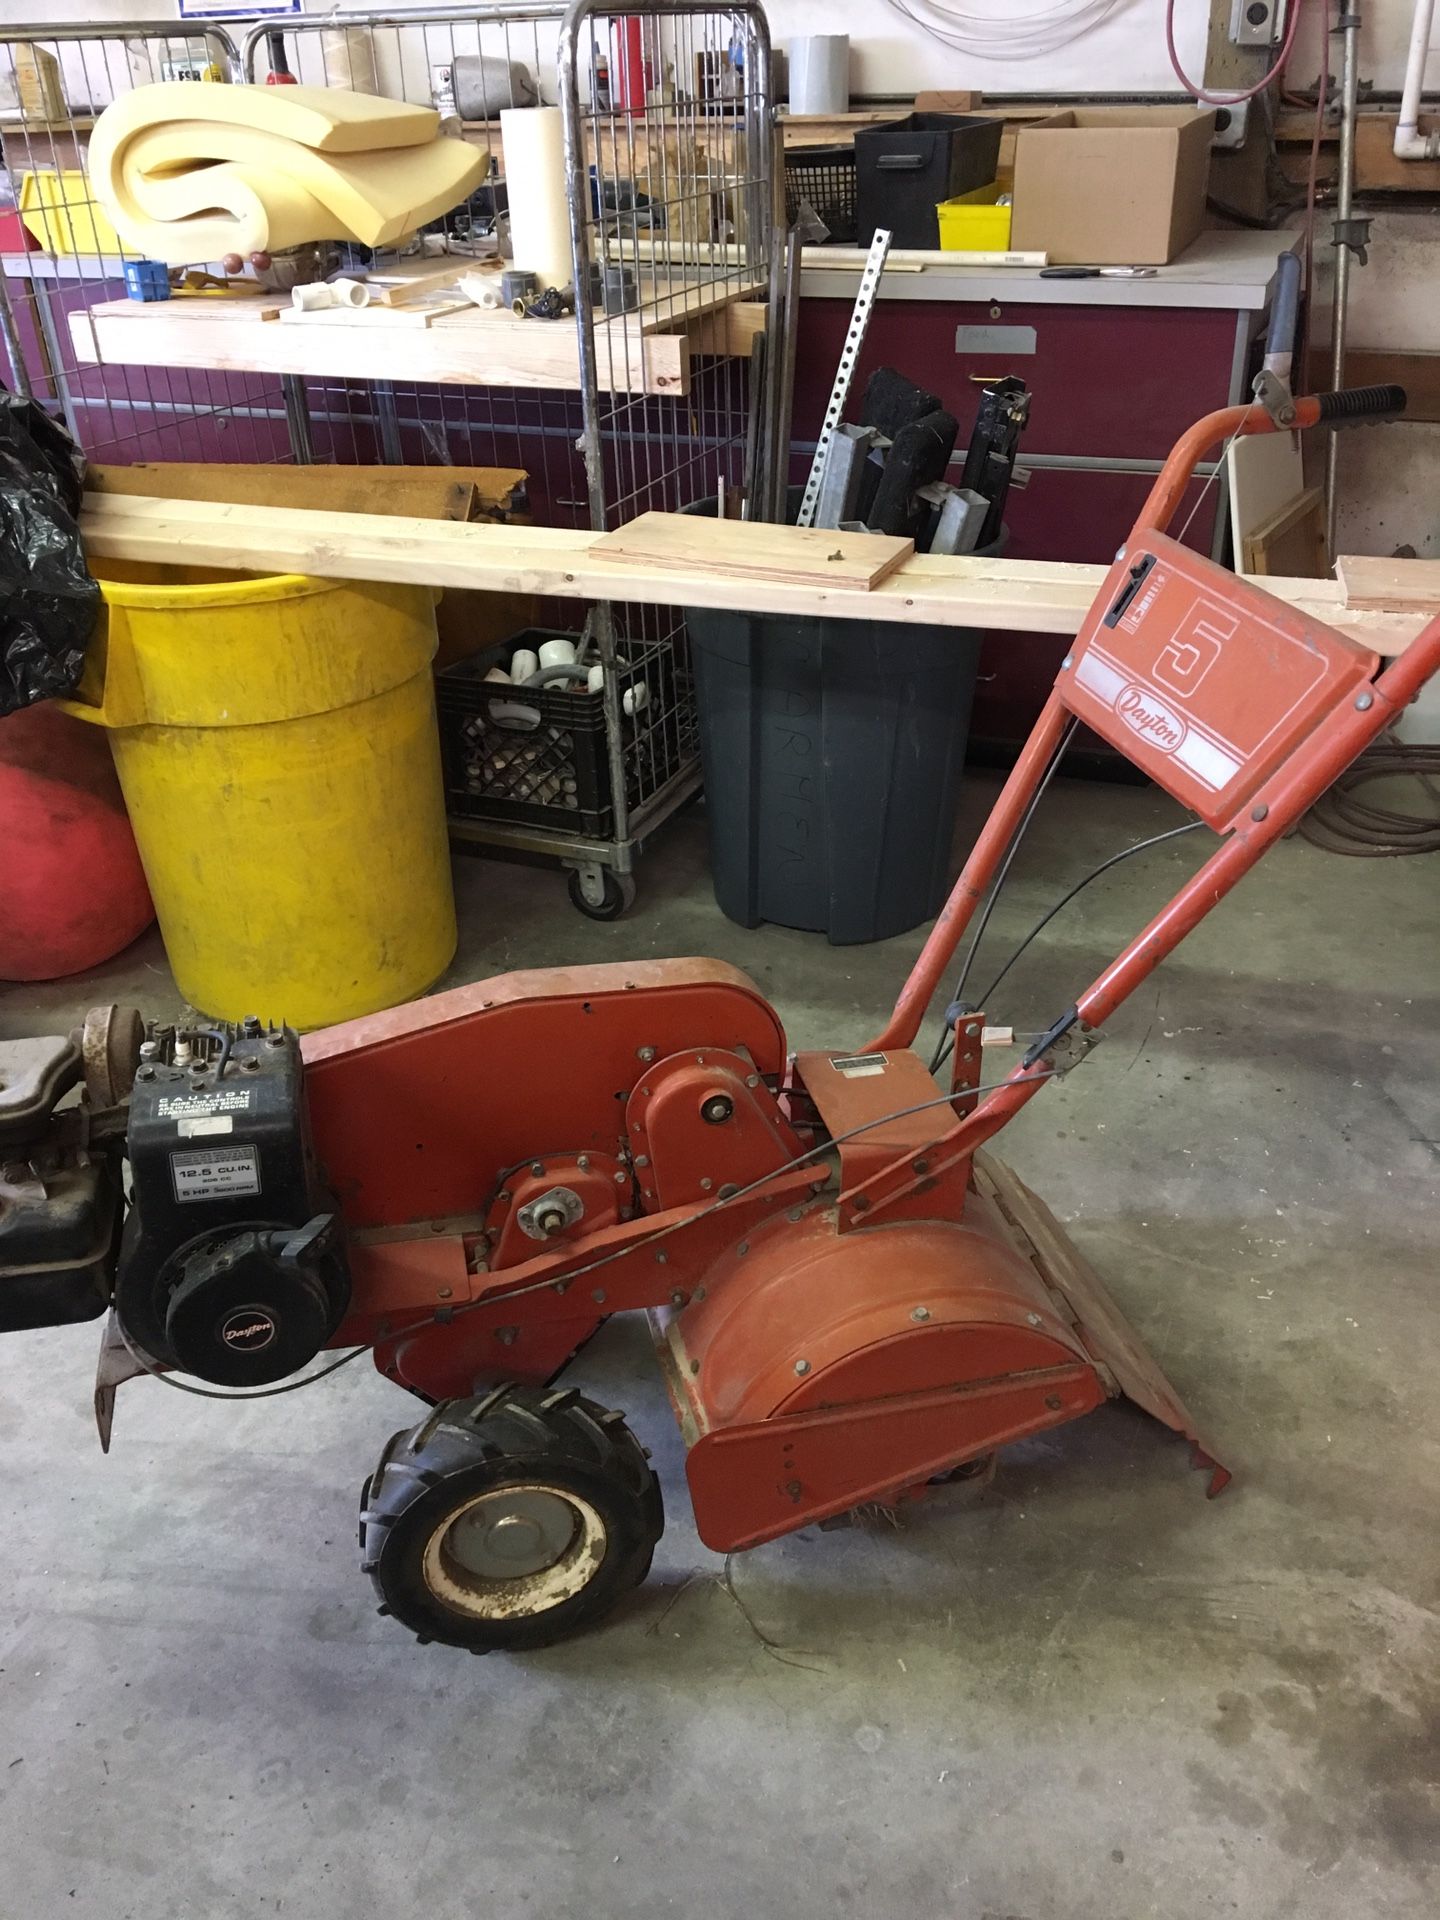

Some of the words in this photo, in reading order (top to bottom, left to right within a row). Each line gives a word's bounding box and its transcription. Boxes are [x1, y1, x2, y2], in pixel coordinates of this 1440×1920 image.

[1152, 597, 1241, 699] 5
[1120, 690, 1179, 746] Dayton
[159, 1090, 250, 1103] CAUTION
[179, 1168, 212, 1178] 12.5
[226, 1322, 271, 1340] Dayton
